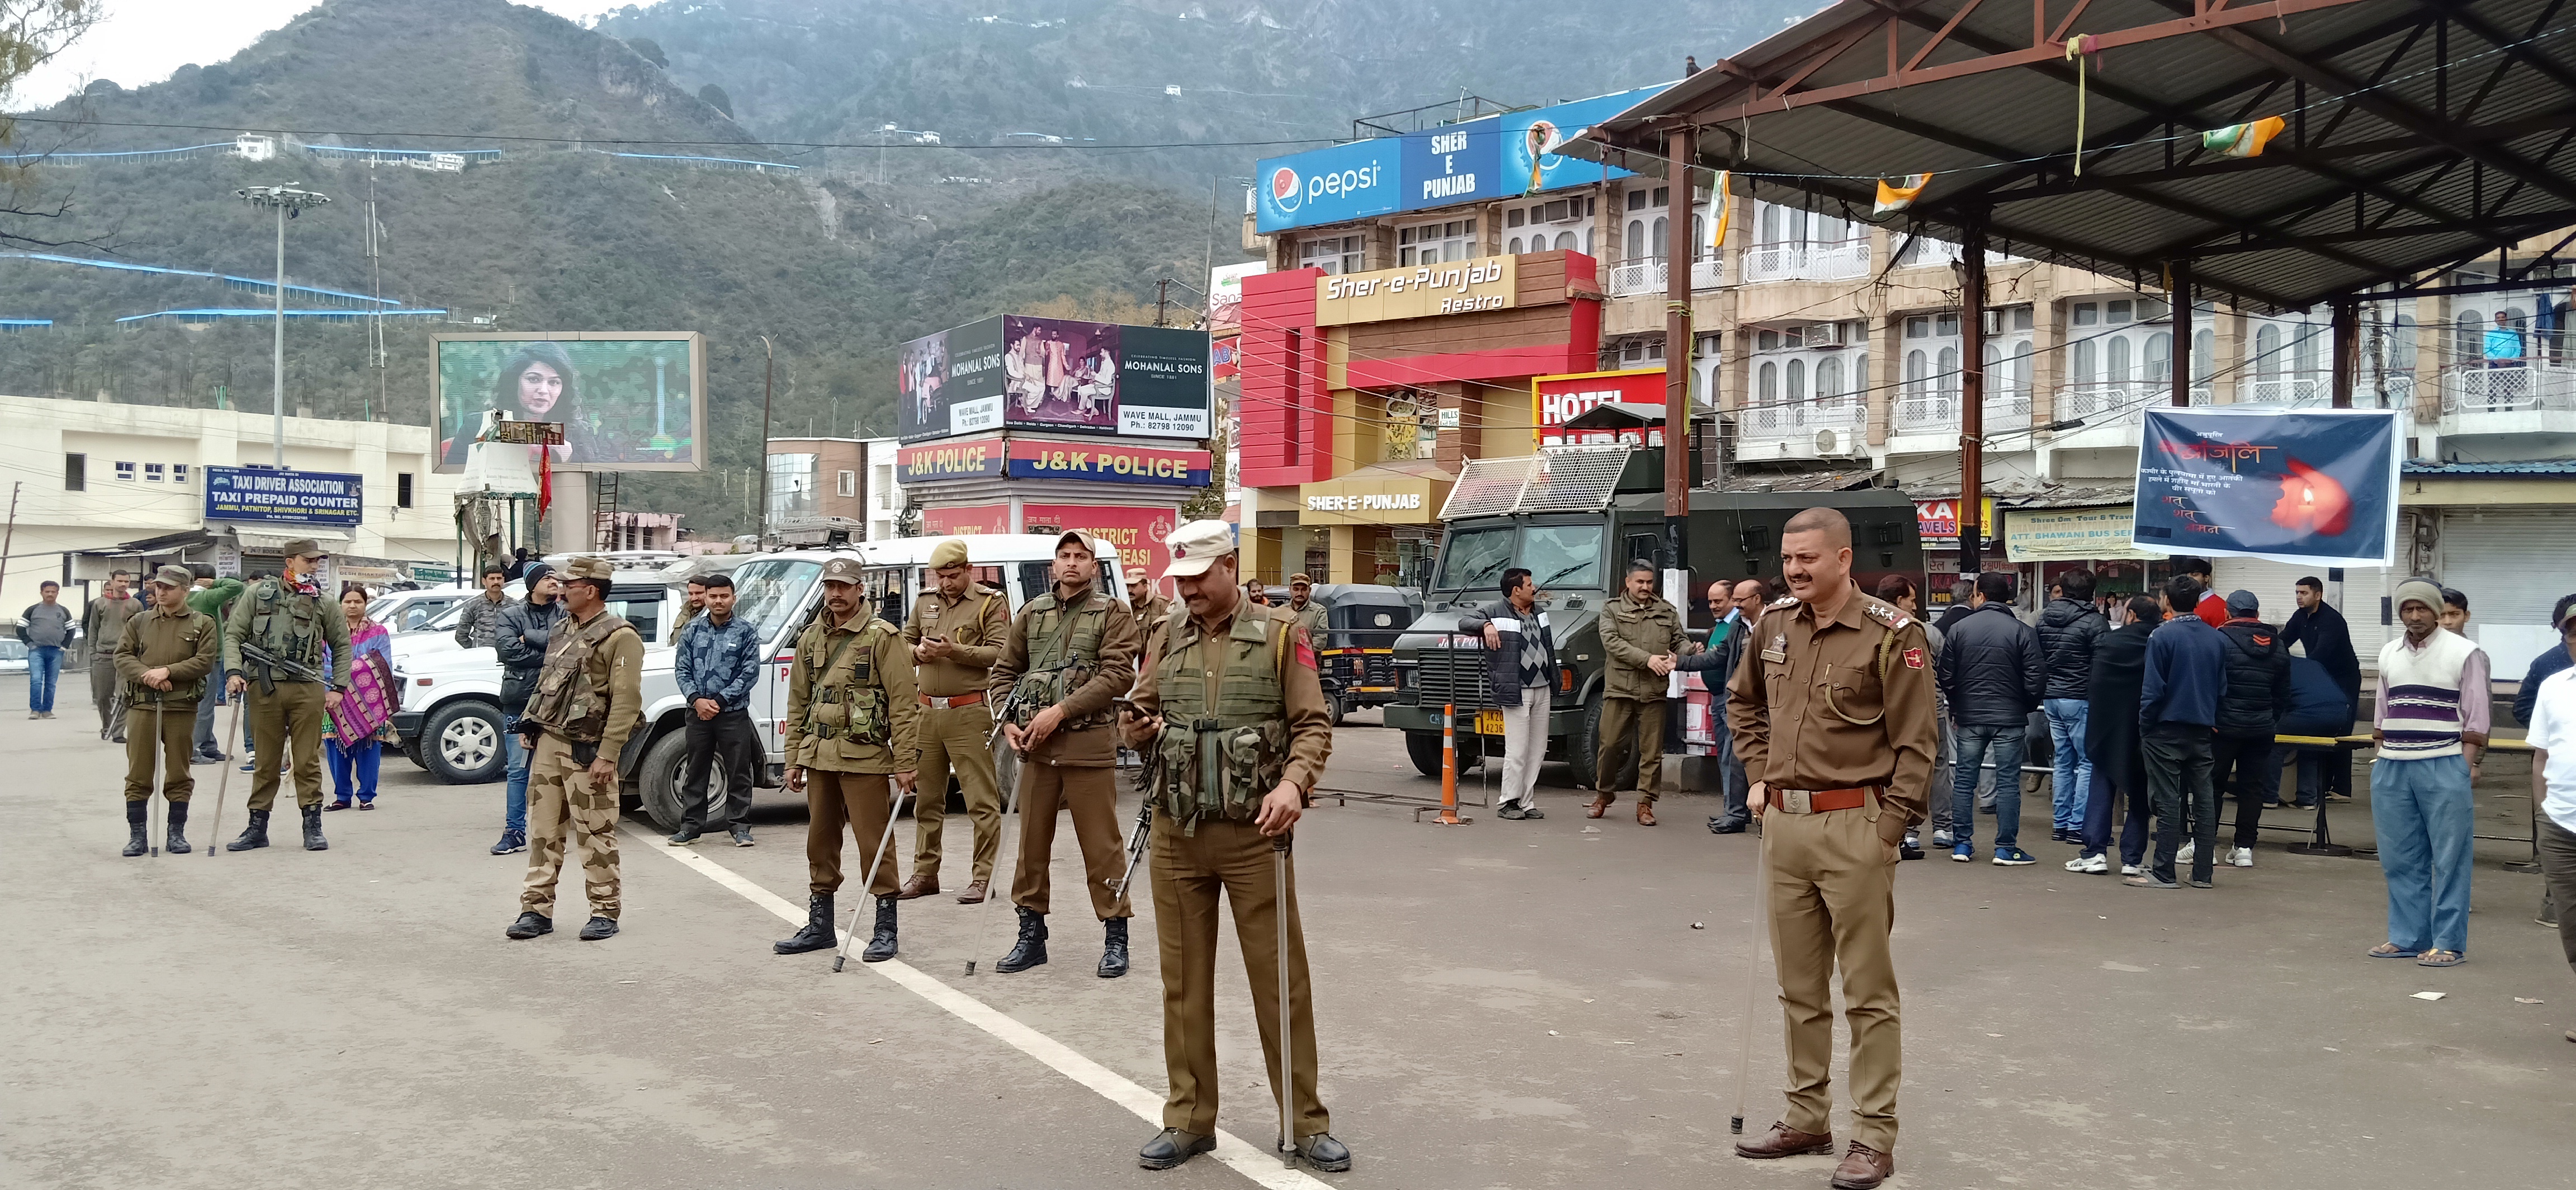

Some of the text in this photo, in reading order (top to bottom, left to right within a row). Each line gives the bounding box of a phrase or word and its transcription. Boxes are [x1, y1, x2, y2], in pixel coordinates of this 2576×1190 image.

[1431, 130, 1467, 155] SHER
[1445, 154, 1453, 174] E
[1308, 159, 1377, 204] pepsi
[1423, 173, 1475, 200] PUNJAB
[1441, 295, 1504, 314] Restro
[951, 353, 1001, 377] MOHANLAL SONS
[1125, 360, 1202, 374] MOHANLAL SONS
[959, 408, 969, 417] WAVE
[980, 403, 993, 413] JAMMU
[1123, 411, 1201, 422] WAVE MALL, JAMMU
[908, 446, 986, 476] J&K POLICE
[1033, 451, 1188, 479] J&K POLICE
[2169, 470, 2196, 479] पुलवामा
[2171, 476, 2189, 485] शहीद
[232, 475, 344, 495] TAXI DRIVER ASSOCIATION
[212, 491, 358, 508] TAXI PREPAID COUNTER
[1307, 494, 1420, 511] SHER-E-PUNJAB
[242, 505, 272, 513] PATNITOP,
[1027, 514, 1060, 524] जय माता दी
[1919, 521, 1956, 534] AVELS
[2035, 531, 2085, 540] BHAWANI
[1981, 560, 2001, 571] रक्षण
[1486, 724, 1503, 733] 4236
